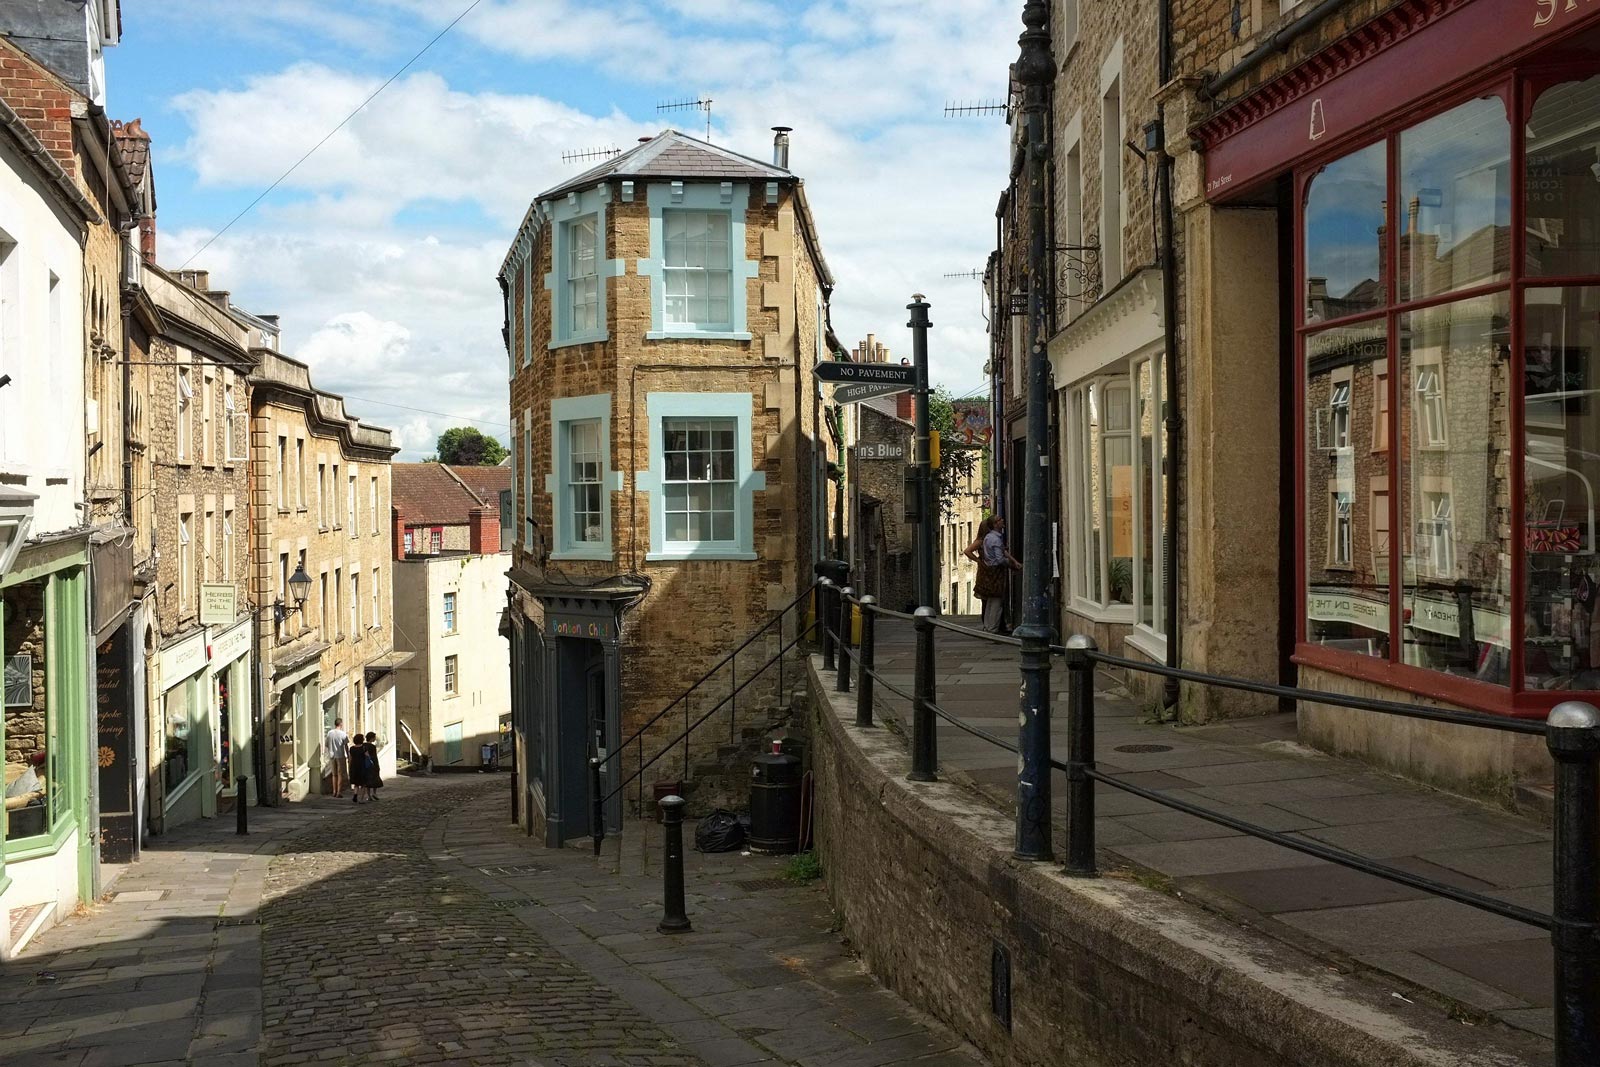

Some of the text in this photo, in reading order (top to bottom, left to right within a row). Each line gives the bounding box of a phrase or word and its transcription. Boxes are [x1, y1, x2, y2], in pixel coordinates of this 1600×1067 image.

[1221, 174, 1232, 185] Street
[840, 368, 907, 380] NO PAVEMENT
[847, 386, 867, 397] HIGH
[878, 444, 902, 456] Blue
[553, 618, 608, 639] Bonbon Chic!
